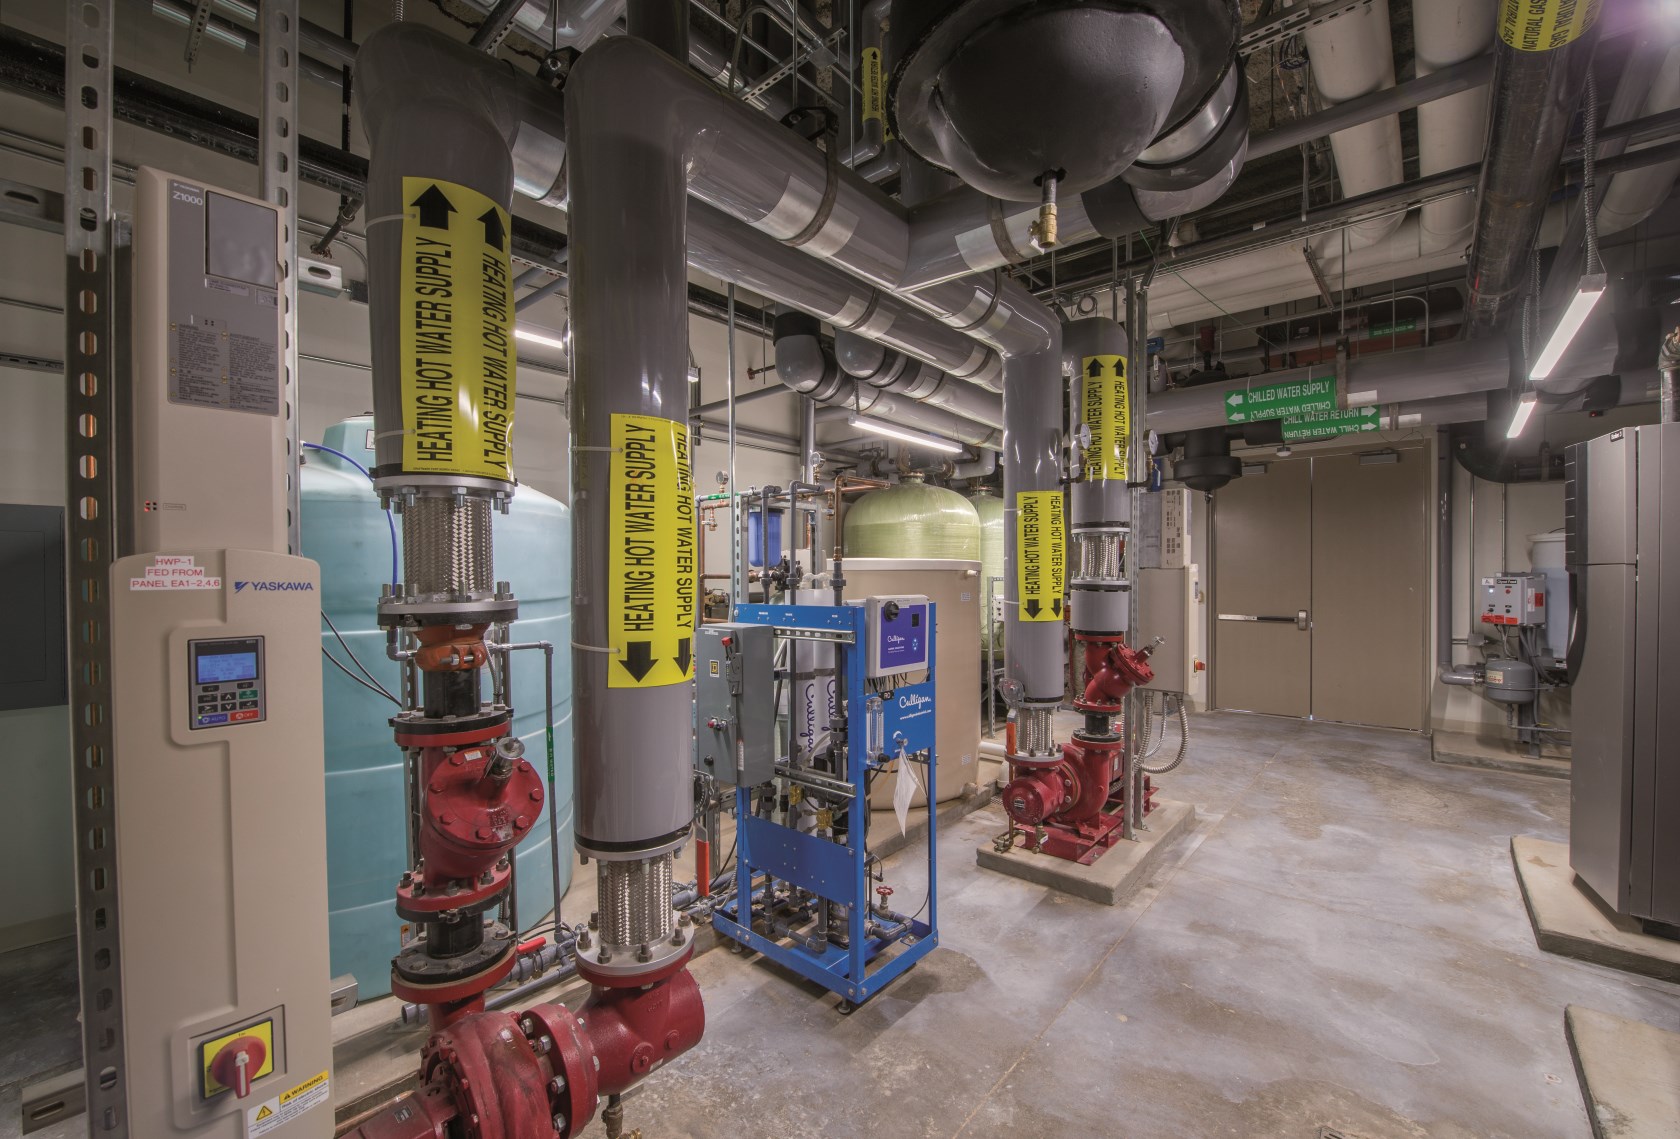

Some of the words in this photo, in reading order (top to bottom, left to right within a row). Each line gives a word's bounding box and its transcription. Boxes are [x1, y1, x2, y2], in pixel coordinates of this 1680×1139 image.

[1522, 17, 1544, 50] NATURAL
[173, 190, 203, 206] Z1000
[415, 236, 452, 298] SUPPLY
[482, 253, 507, 320] HEATING
[416, 300, 453, 355] WATER
[482, 318, 507, 356] HOT
[416, 358, 453, 392] HOT
[482, 354, 507, 411] WATER
[1087, 381, 1102, 407] SUPPLY
[1114, 381, 1125, 409] HEATING
[1248, 389, 1275, 403] CHILLED
[1277, 385, 1301, 399] WATER
[1302, 381, 1330, 396] SUPPLY
[1087, 408, 1102, 431] WATER
[1114, 410, 1125, 425] HOT
[1250, 408, 1275, 422] SUPPLY
[1277, 405, 1301, 416] WATER
[1283, 414, 1302, 425] CHILL
[1304, 411, 1329, 422] WATER
[1330, 408, 1359, 419] RETURN
[1302, 401, 1331, 412] CHILLED
[416, 394, 453, 462] HEATING
[483, 409, 507, 471] SUPPLY
[1114, 426, 1125, 448] WATER
[1284, 429, 1312, 440] RETURN
[1312, 426, 1338, 435] WATER
[1339, 424, 1360, 434] CHILL
[625, 423, 656, 480] SUPPLY
[676, 432, 692, 494] HEATING
[1087, 447, 1102, 476] HEATING
[625, 483, 655, 533] WATER
[677, 495, 693, 524] HOT
[1023, 496, 1039, 523] SUPPLY
[1050, 495, 1061, 525] HEATING
[1024, 523, 1039, 549] WATER
[1050, 526, 1062, 541] HOT
[625, 537, 655, 566] HOT
[676, 527, 693, 574] WATER
[1024, 549, 1040, 564] HOT
[1051, 542, 1063, 567] WATER
[132, 580, 167, 588] PANEL
[172, 568, 203, 576] FROM
[1025, 565, 1040, 595] HEATING
[1051, 568, 1062, 594] SUPPLY
[251, 581, 314, 591] YASKAWA
[624, 570, 655, 632] HEATING
[676, 577, 693, 628] SUPPLY
[887, 635, 905, 644] Culligan
[899, 693, 931, 709] Culligan
[800, 684, 815, 752] Culligan
[291, 1075, 324, 1096] WARNING
